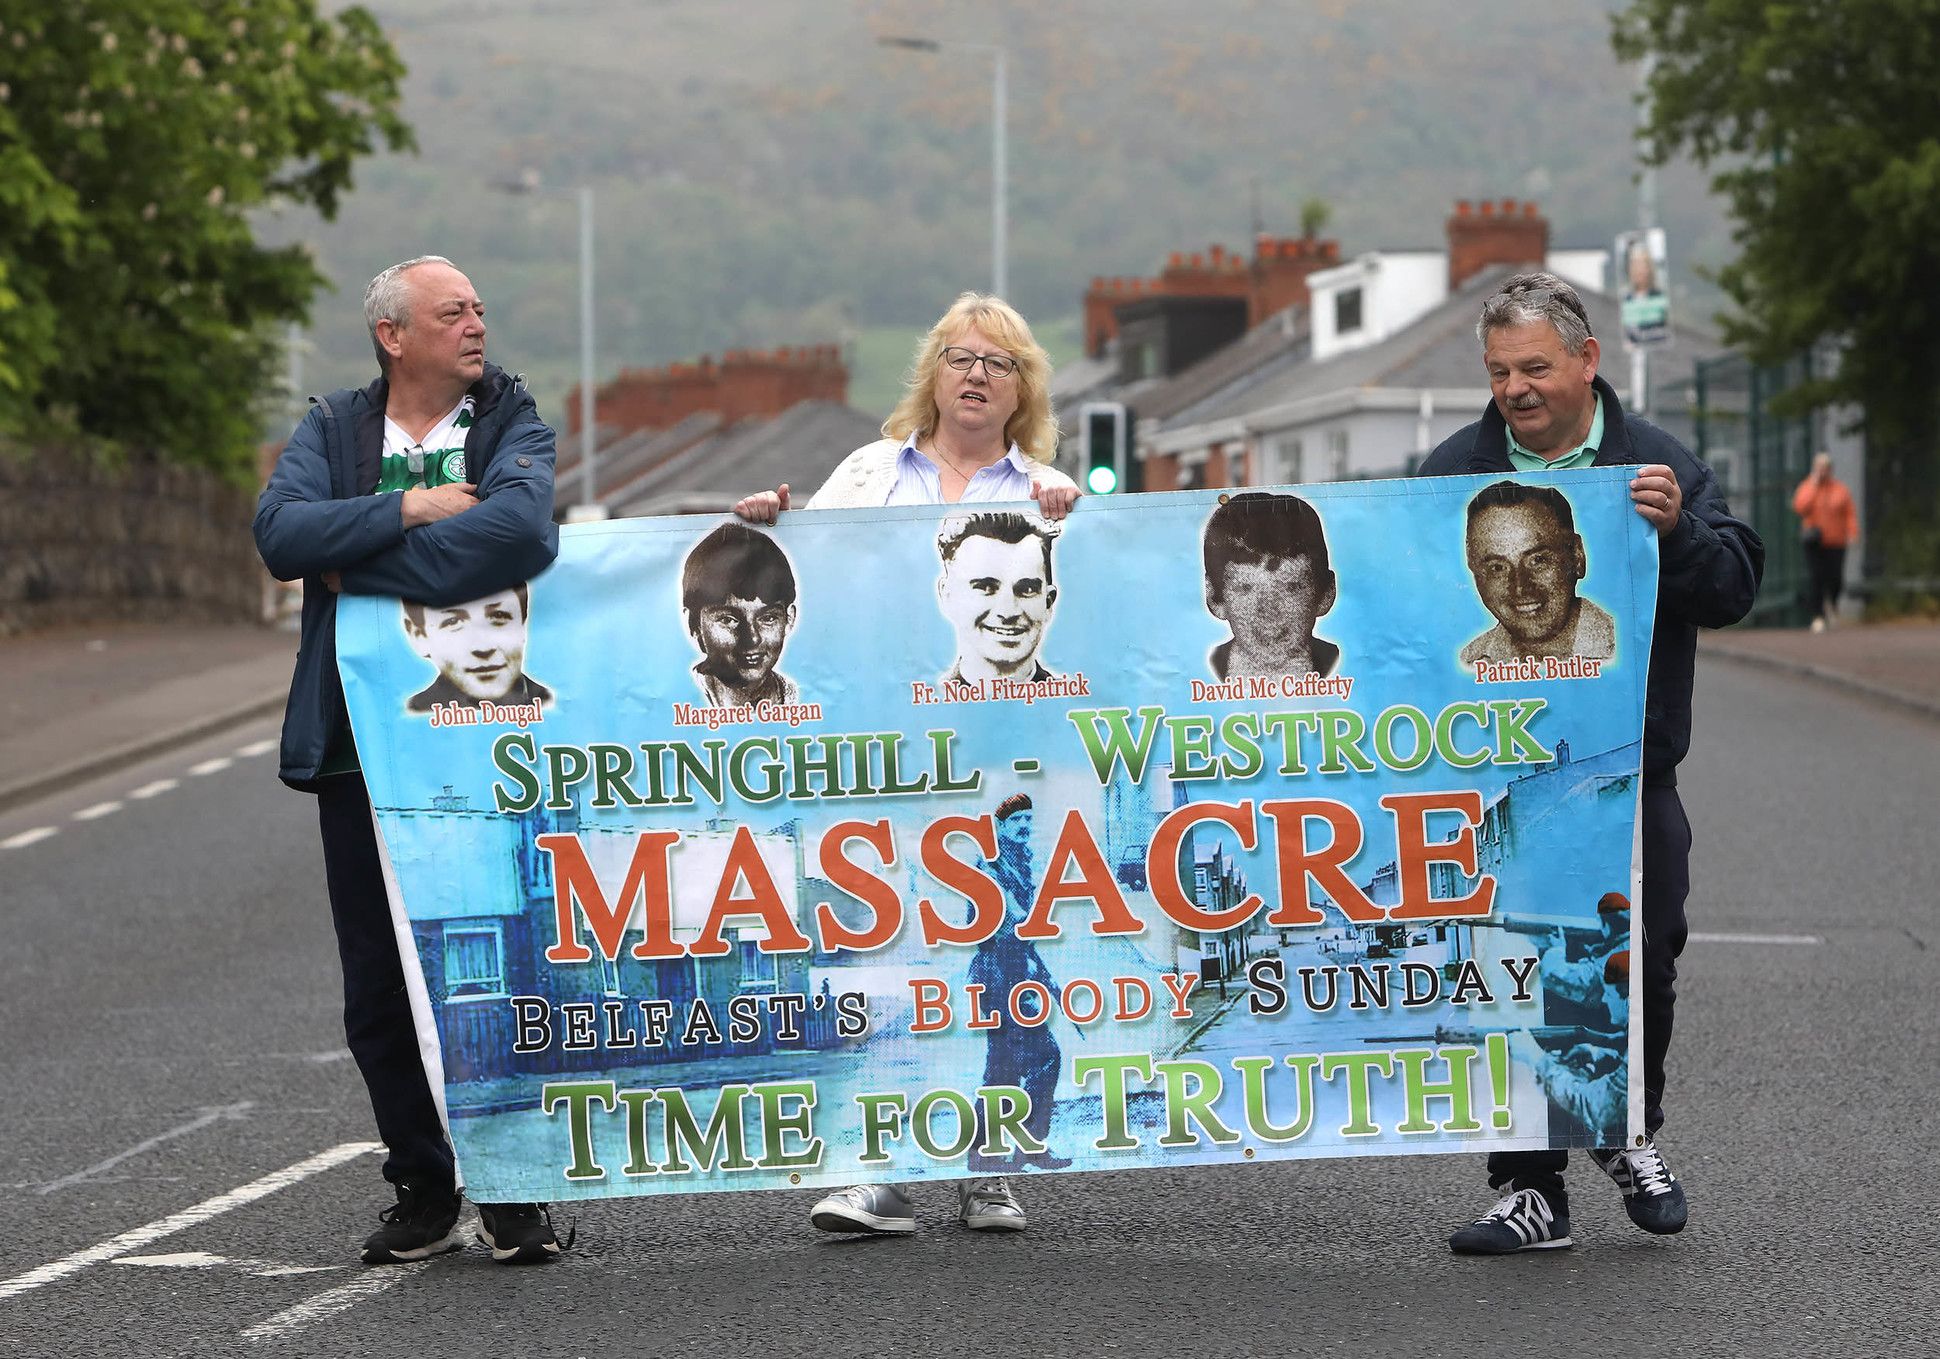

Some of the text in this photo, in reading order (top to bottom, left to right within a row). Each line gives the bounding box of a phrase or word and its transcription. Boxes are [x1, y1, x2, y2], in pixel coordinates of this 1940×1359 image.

[1475, 655, 1601, 684] Patrick Butler
[913, 673, 1090, 704] Fr. Noel Fitzpatrick
[1191, 673, 1354, 702] David Mc Cafferty
[430, 698, 543, 727] John Dougal
[674, 701, 822, 730] Margaret Gargan
[495, 732, 981, 812] SPRINGHILL
[1069, 699, 1554, 785] WESTROCK
[536, 790, 1498, 963] MASSACRE
[908, 971, 1197, 1034] BLOODY
[1248, 957, 1539, 1015] SUNDAY
[542, 1034, 1513, 1181] TIME FOR TRUTH!
